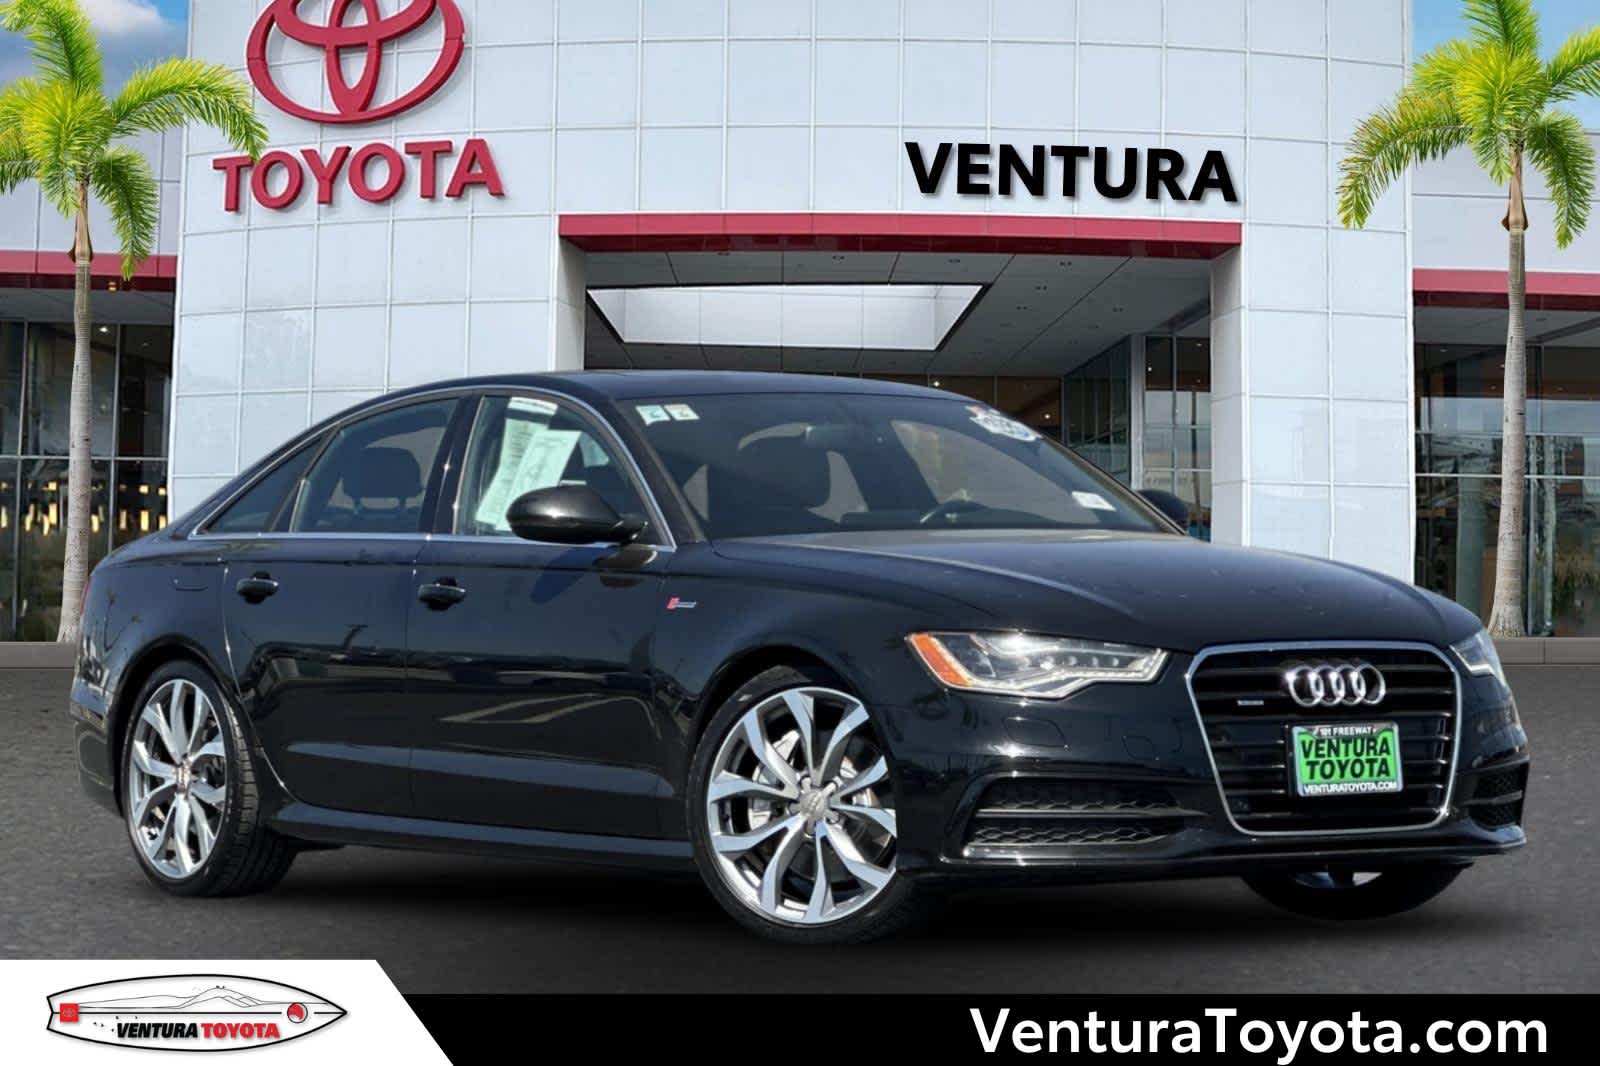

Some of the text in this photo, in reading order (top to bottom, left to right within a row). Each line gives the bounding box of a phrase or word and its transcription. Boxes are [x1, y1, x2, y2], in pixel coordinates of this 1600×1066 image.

[213, 138, 505, 212] TOYOTA
[904, 142, 1238, 202] VENTURA
[1332, 726, 1372, 736] FREEWAY
[1301, 736, 1391, 759] VENTURA
[1306, 758, 1390, 780] TOYOTA
[1303, 781, 1397, 794] VENTURATOYOTA.COM
